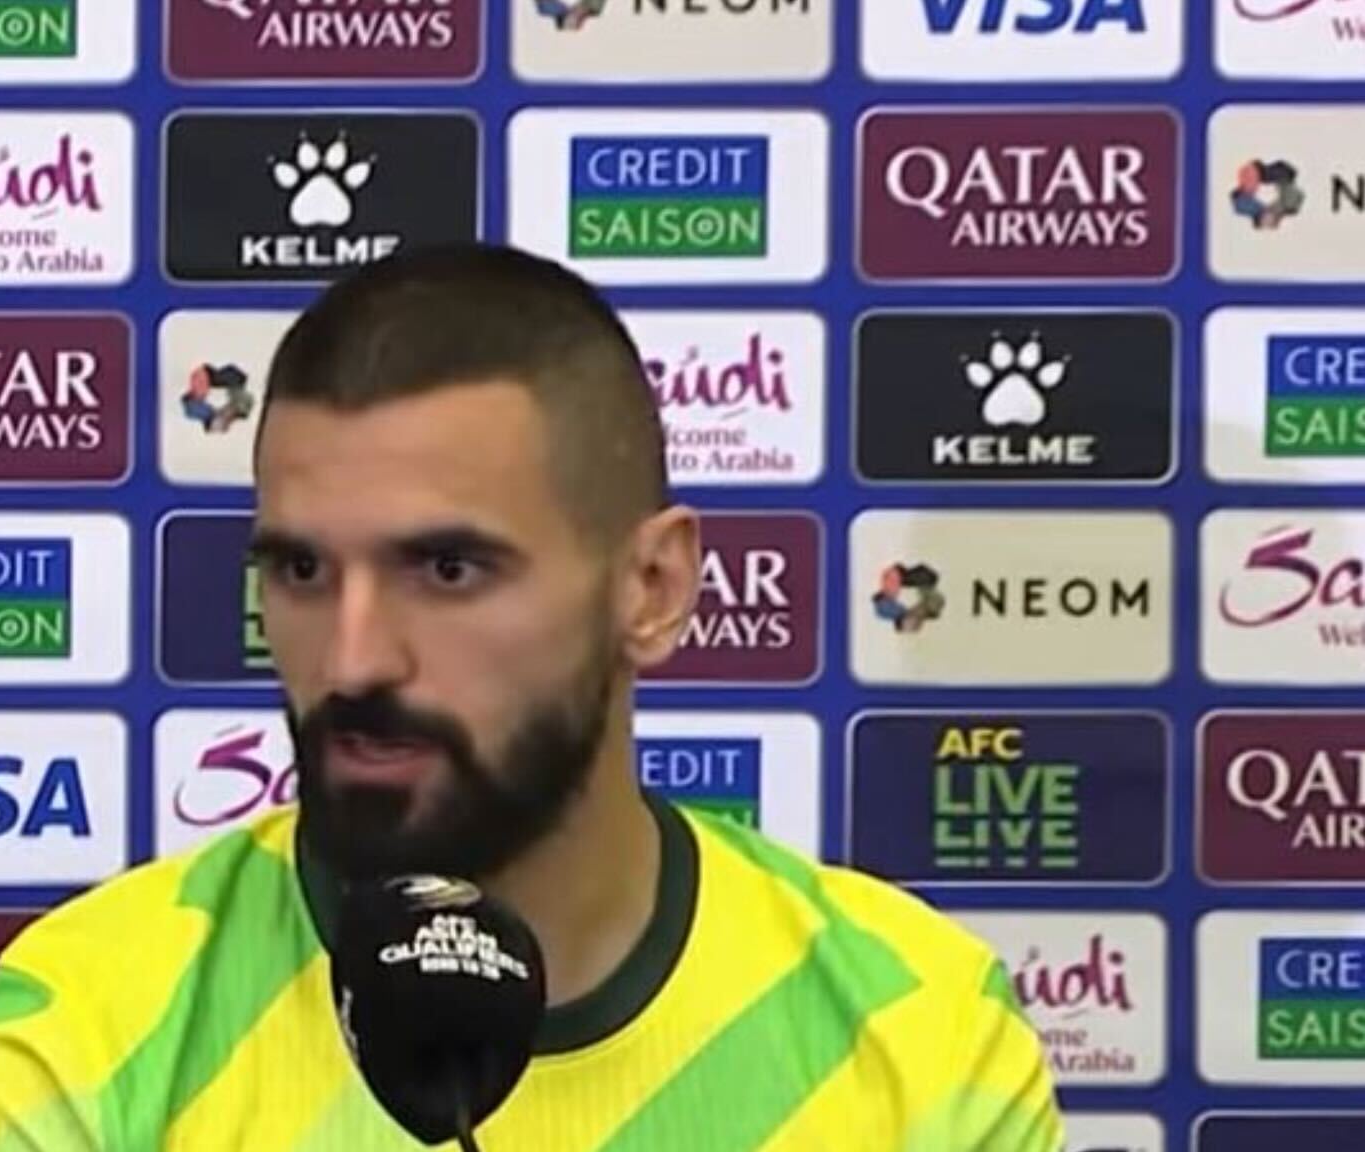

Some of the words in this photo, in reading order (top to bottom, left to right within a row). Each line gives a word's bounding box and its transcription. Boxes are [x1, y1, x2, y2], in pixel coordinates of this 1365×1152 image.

[258, 12, 452, 47] AIRWAYS
[588, 148, 750, 186] CREDIT
[886, 146, 1147, 217] QATAR
[578, 207, 760, 246] SAISON
[951, 212, 1148, 247] AIRWAYS
[16, 249, 105, 274] Arabia
[671, 451, 699, 472] to
[705, 447, 794, 473] Arabia
[933, 435, 1097, 466] KELME
[972, 579, 1150, 617] NEOM
[937, 728, 1022, 758] AFC
[934, 766, 1078, 814] LIVE
